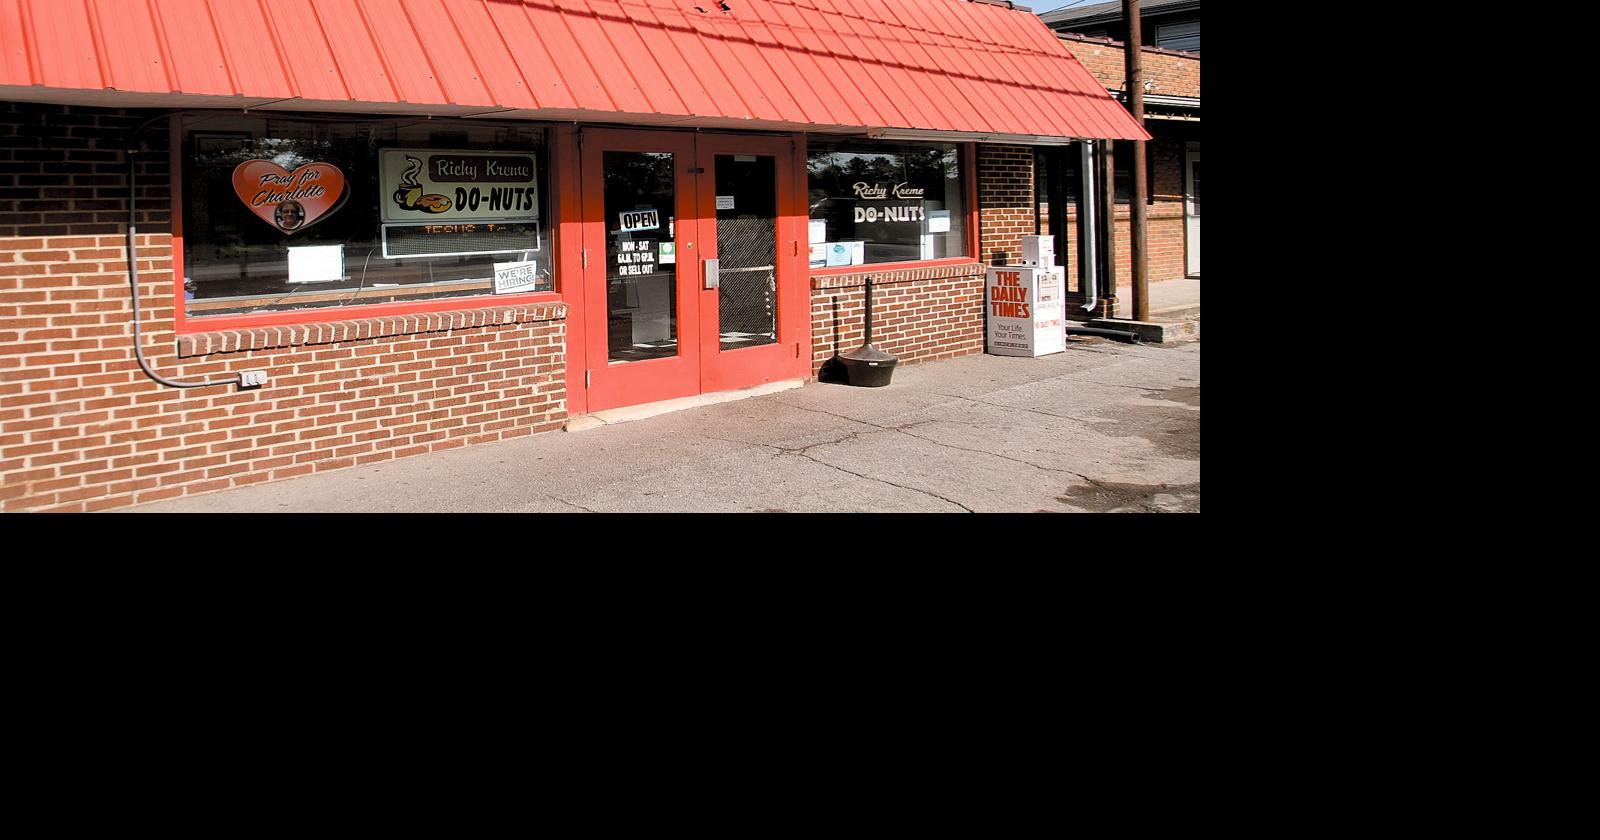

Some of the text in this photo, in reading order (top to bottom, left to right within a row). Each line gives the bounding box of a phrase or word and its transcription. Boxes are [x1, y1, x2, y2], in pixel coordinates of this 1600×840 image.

[436, 158, 529, 180] Richy Kreme
[259, 168, 321, 188] Pray for
[251, 185, 326, 207] Charlotte
[852, 181, 924, 199] Richy Kreme
[454, 186, 535, 212] DO-NUTS
[623, 211, 657, 229] OPEN
[854, 206, 926, 223] DO-NUTS
[622, 241, 635, 252] MON
[638, 240, 650, 251] SAT
[632, 252, 641, 263] TO
[498, 266, 533, 280] WE'RE
[619, 264, 654, 276] OR SELL OUT
[498, 274, 535, 288] HIRING!
[995, 271, 1021, 286] THE
[991, 286, 1028, 302] DAILY
[991, 302, 1030, 318] TIMES
[993, 331, 1008, 339] Your
[997, 323, 1011, 331] Your
